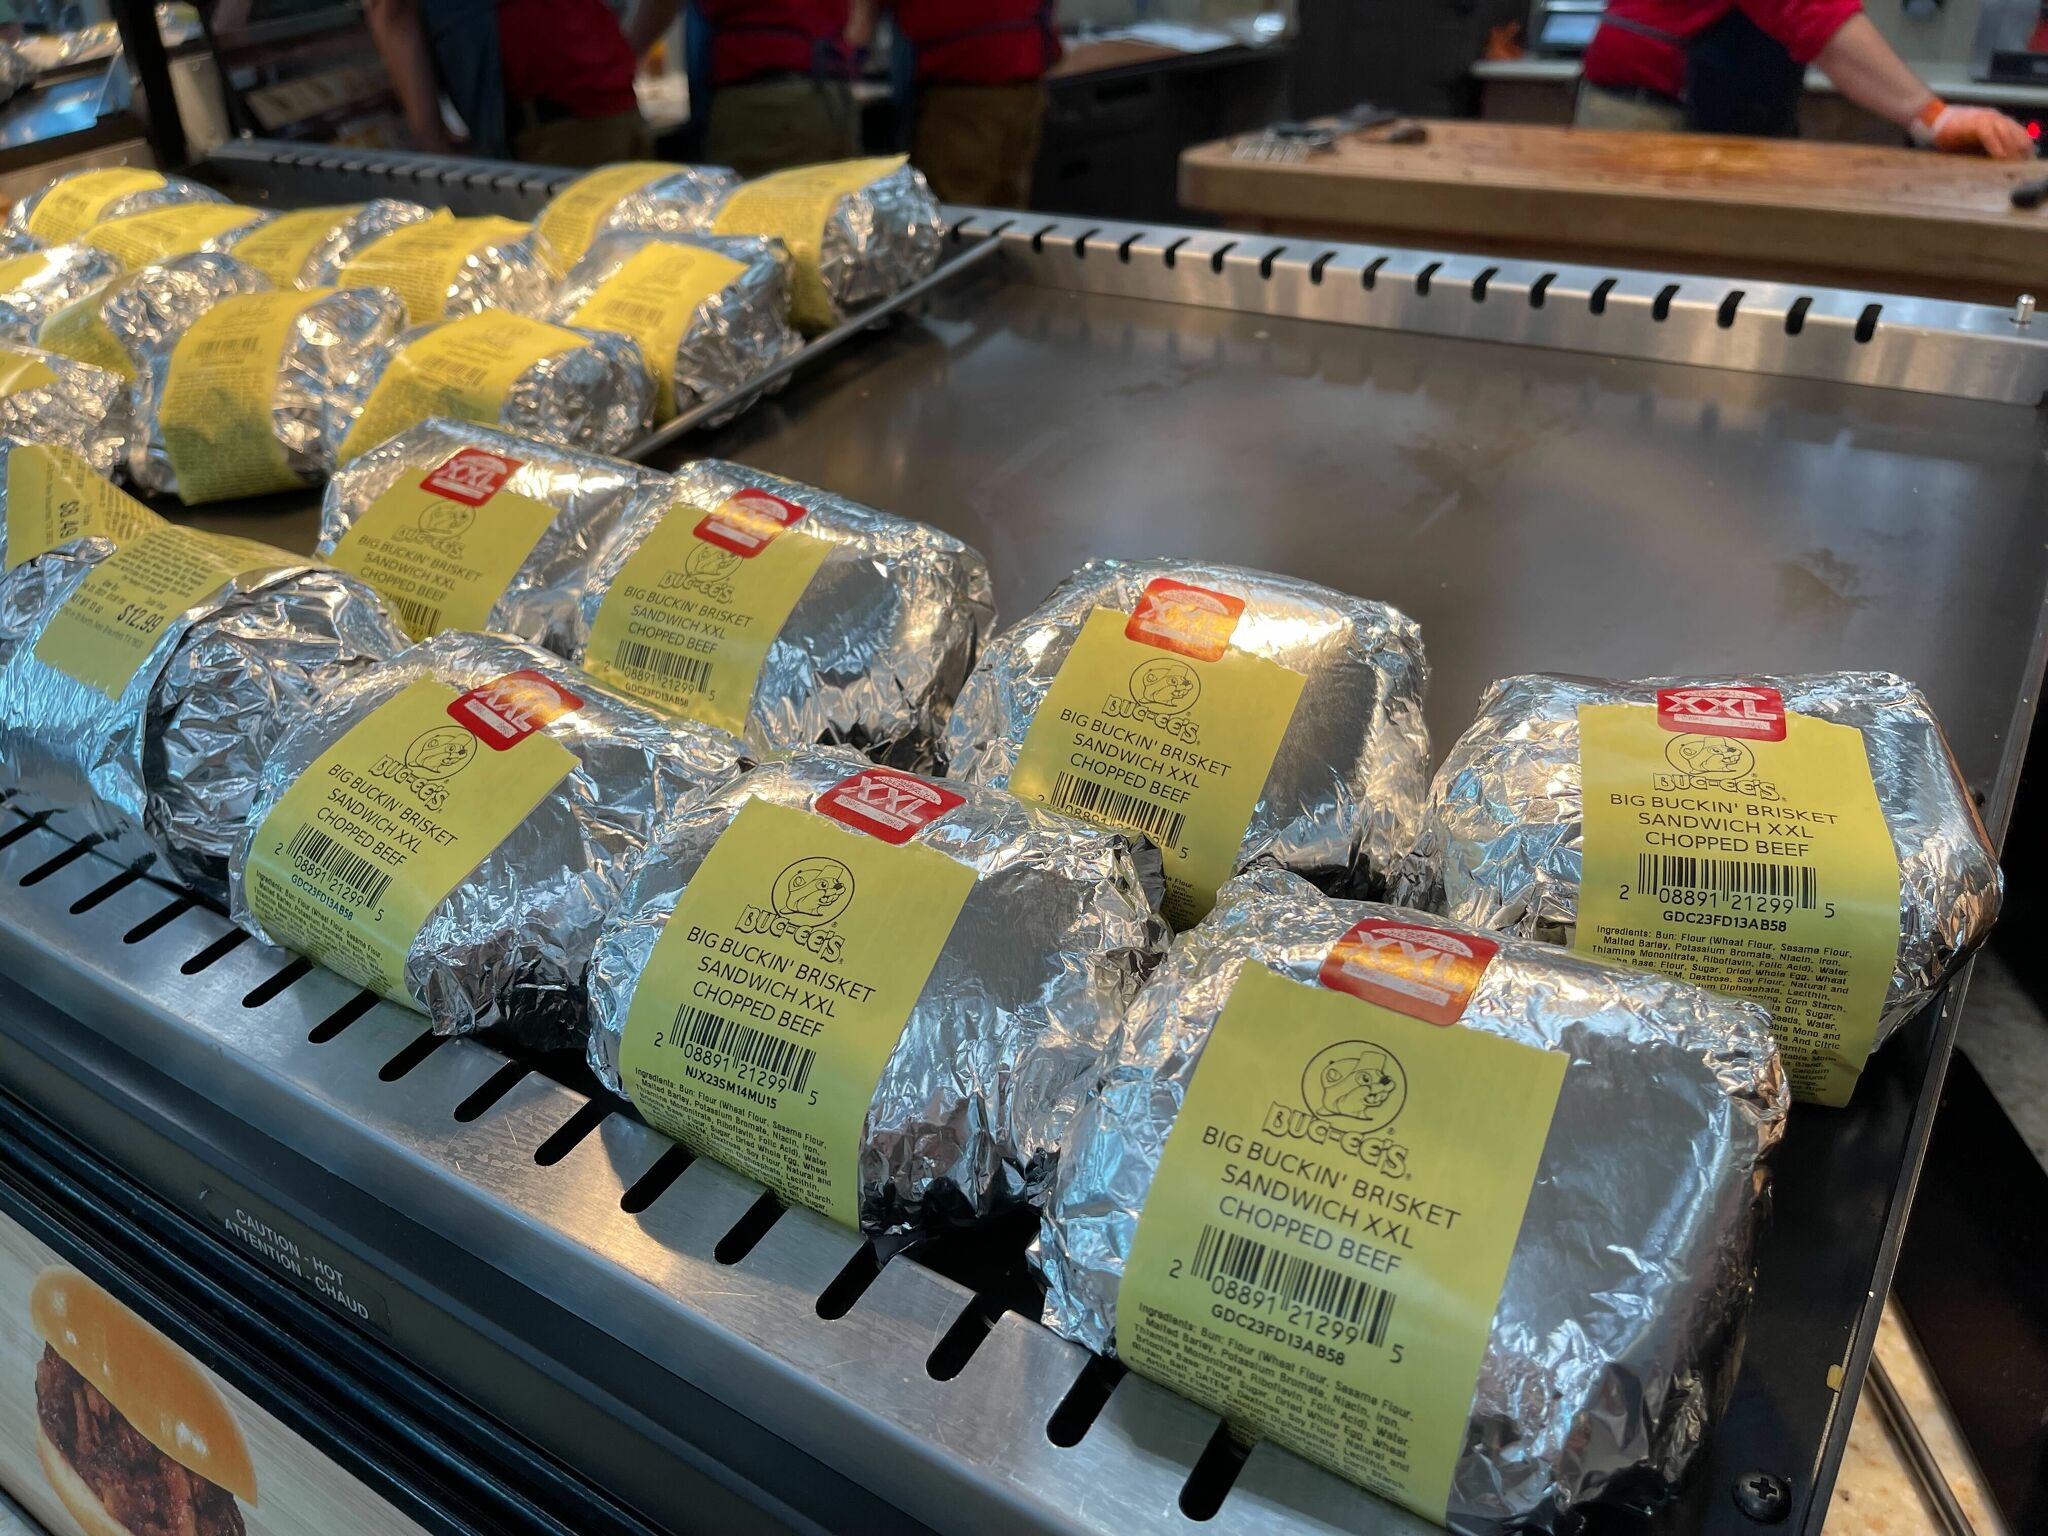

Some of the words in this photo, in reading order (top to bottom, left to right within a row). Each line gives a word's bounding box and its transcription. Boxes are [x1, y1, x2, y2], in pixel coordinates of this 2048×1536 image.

[358, 535, 377, 550] BIG
[431, 558, 483, 583] BRISKET
[365, 552, 431, 581] SANDWICH
[433, 573, 456, 590] XXL
[360, 567, 415, 592] CHOPPED
[417, 583, 449, 603] BEEF
[624, 585, 644, 600] BIG
[647, 592, 699, 614] BUCKIN'
[698, 603, 753, 628] BRISKET
[117, 604, 164, 633] $12.99
[628, 622, 684, 647] CHOPPED
[687, 638, 718, 655] BEEF
[631, 605, 705, 632] SANDWICH
[703, 623, 726, 640] XXL
[604, 661, 610, 672] 2
[624, 666, 655, 684] 08891
[662, 677, 694, 695] 21299
[709, 690, 716, 701] 5
[1665, 696, 1777, 720] XXL
[1060, 709, 1089, 727] BIG
[1091, 719, 1158, 750] BUCKIN'
[1160, 744, 1231, 777] BRISKET
[1073, 733, 1164, 774] SANDWICH
[1166, 766, 1199, 788] XXL
[838, 776, 927, 824] XXL
[1070, 753, 1146, 789] CHOPPED
[1149, 780, 1191, 804] BEEF
[328, 764, 353, 783] BIG
[350, 777, 403, 812] BUCKIN'
[400, 807, 458, 846] BRISKET
[328, 788, 398, 836] SANDWICH
[394, 829, 422, 854] XXL
[1611, 794, 1645, 806] BIG
[1652, 797, 1738, 813] BUCKIN'
[1747, 805, 1838, 824] BRISKET
[1639, 812, 1760, 834] SANDWICH
[1768, 823, 1814, 838] XXL
[317, 807, 374, 847] CHOPPED
[372, 842, 407, 866] BEEF
[1179, 847, 1188, 859] 5
[1646, 832, 1748, 851] CHOPPED
[1756, 840, 1809, 856] BEEF
[274, 842, 283, 855] 2
[295, 856, 326, 884] 08891
[329, 879, 364, 907] 21299
[375, 909, 384, 921] 5
[292, 874, 353, 920] GDC23FD13AB58
[1619, 885, 1629, 900] 2
[1659, 888, 1717, 908] 08891
[1731, 895, 1793, 914] 21299
[1824, 903, 1835, 918] 5
[1597, 925, 1651, 938] Ingredients:
[1681, 934, 1706, 943] Flour
[1710, 936, 1743, 946] (Wheat
[1781, 944, 1819, 954] Sesame
[1663, 910, 1786, 932] GDC23FD13AB58
[687, 927, 719, 948] BIG
[720, 938, 794, 973] BUCKIN'
[795, 964, 876, 1003] BRISKET
[1593, 945, 1635, 956] Thiamine
[1604, 936, 1634, 946] Malted
[1676, 943, 1725, 954] Potassium
[698, 957, 798, 1002] SANDWICH
[799, 992, 835, 1018] XXL
[1791, 981, 1826, 990] Natural
[693, 981, 775, 1021] CHOPPED
[778, 1010, 824, 1037] BEEF
[654, 1032, 664, 1047] 2
[684, 1044, 730, 1072] 08891
[738, 1064, 787, 1093] 21299
[808, 1091, 819, 1105] 5
[685, 1066, 777, 1109] NJX23SM14MU15
[699, 1092, 717, 1104] Flour
[1202, 1126, 1243, 1153] BIG
[1247, 1141, 1347, 1189] BUCKIN'
[1352, 1178, 1461, 1229] BRISKET
[1221, 1164, 1358, 1228] SANDWICH
[1362, 1214, 1413, 1248] XXL
[236, 1209, 300, 1258] CAUTION
[313, 1256, 343, 1286] HOT
[1219, 1195, 1332, 1251] CHOPPED
[1338, 1237, 1402, 1274] BEEF
[225, 1219, 302, 1277] ATTENTION
[315, 1279, 368, 1319] CHAUD
[1169, 1259, 1183, 1279] 2
[1211, 1275, 1276, 1315] 08891
[1288, 1304, 1359, 1345] 21299
[1389, 1344, 1405, 1364] 5
[1211, 1304, 1345, 1366] GDC23FD13AB58
